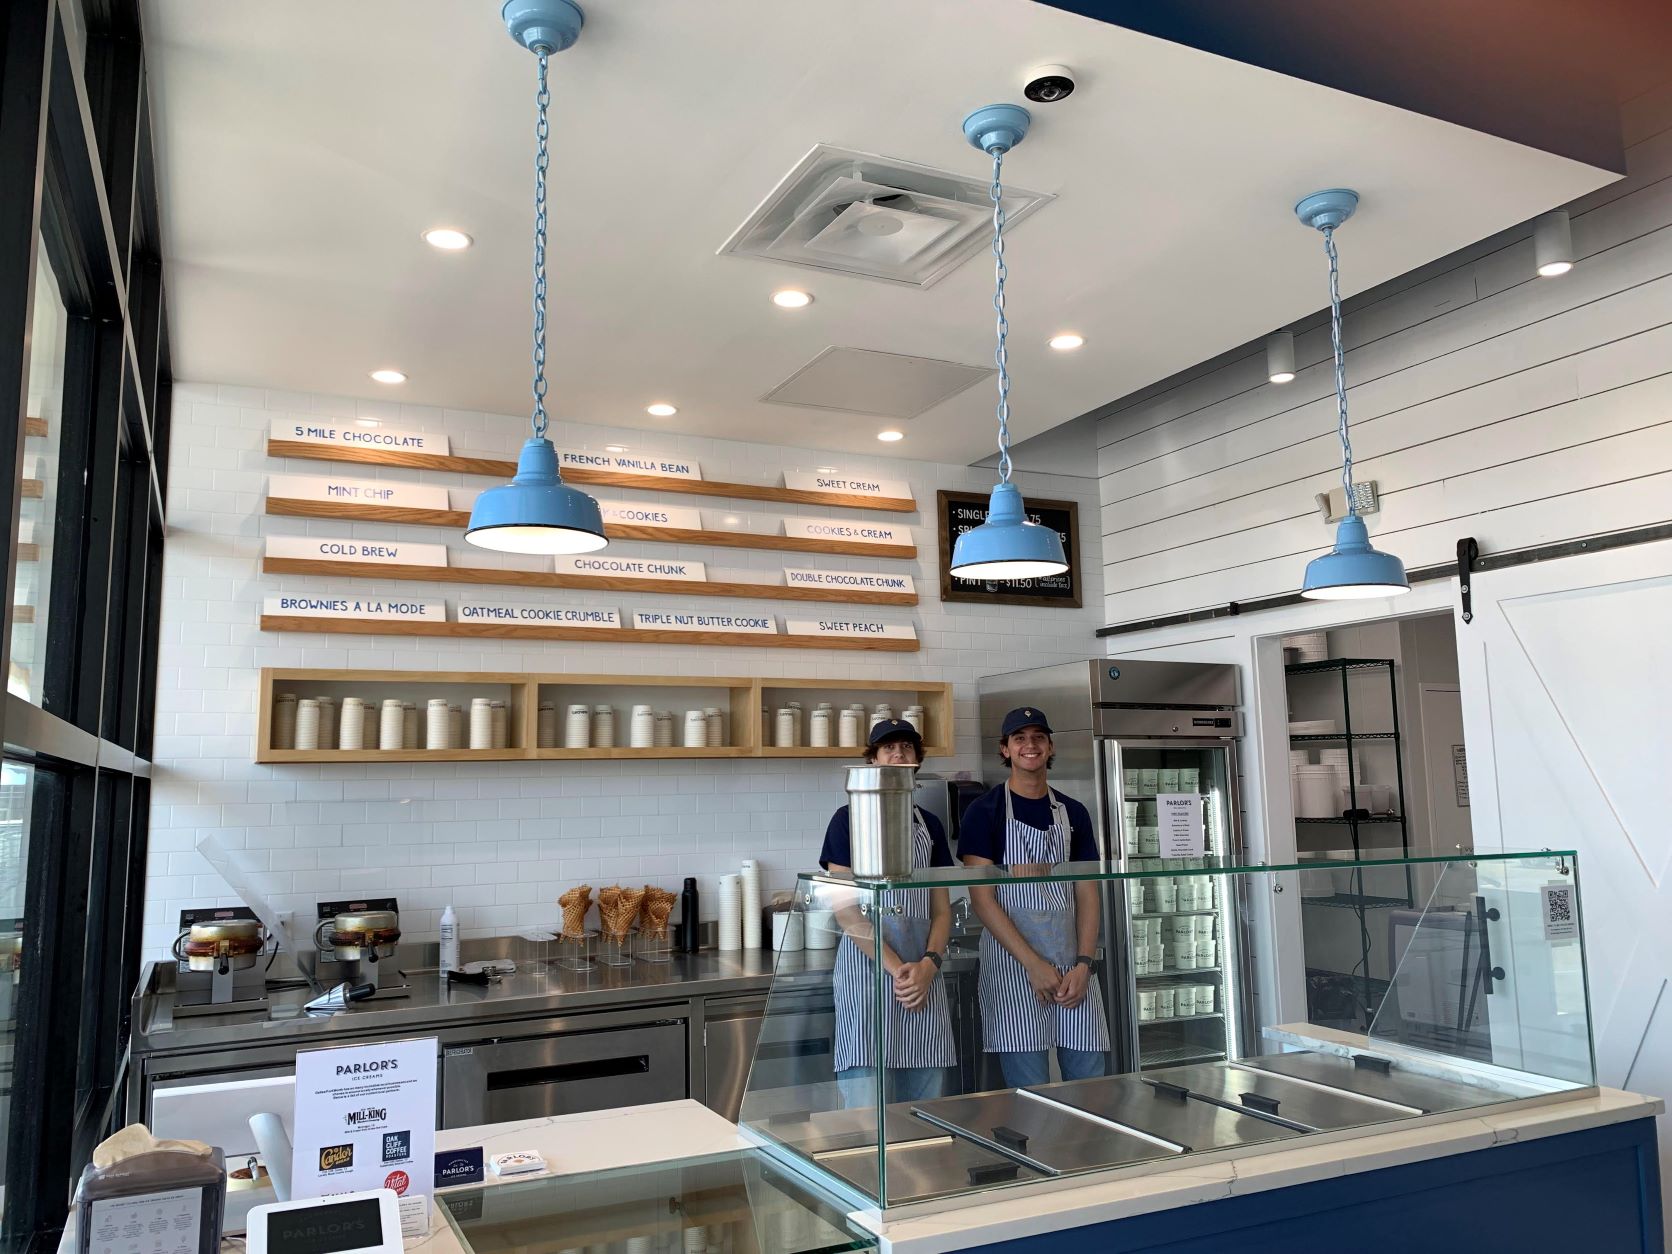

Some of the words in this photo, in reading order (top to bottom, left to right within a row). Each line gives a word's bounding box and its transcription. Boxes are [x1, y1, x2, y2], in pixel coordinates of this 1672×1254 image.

[295, 426, 304, 437] 5
[307, 428, 336, 440] MILE
[343, 431, 424, 448] CHOCOLATE
[564, 453, 610, 467] FRENCH
[615, 457, 657, 472] VANILLA
[661, 462, 690, 474] BEAN
[328, 485, 359, 499] MINT
[364, 487, 394, 501] CHIP
[816, 478, 848, 490] SWEET
[849, 481, 880, 493] CREAM
[619, 510, 668, 523] COOKIES
[806, 524, 853, 537] COOKIES
[860, 528, 893, 540] CREAM
[319, 543, 357, 556] COLD
[361, 546, 398, 558] BREW
[574, 559, 643, 574] CHOCOLATE
[647, 563, 687, 576] CHUNK
[790, 572, 823, 584] DOUBLE
[825, 575, 875, 588] CHOCOLATE
[876, 577, 905, 588] CHUNK
[280, 598, 348, 612] BROWNIES
[353, 601, 362, 612] A
[367, 602, 383, 613] LA
[388, 603, 426, 615] MODE
[462, 606, 518, 619] OATMEAL
[520, 608, 563, 621] COOKIE
[565, 610, 615, 623] CRUMBLE
[638, 613, 672, 626] TRIPLE
[674, 615, 695, 626] NUT
[697, 616, 733, 628] BUTTER
[734, 617, 769, 629] COOKIE
[819, 621, 850, 632] SWEET
[853, 622, 885, 634] PEACH
[336, 1059, 398, 1076] PARLOR'S
[347, 1108, 387, 1125] MILL-KING
[385, 1140, 402, 1149] CLIFF
[386, 1135, 399, 1143] OAK
[385, 1146, 407, 1155] COFFEE
[442, 1165, 474, 1176] PARLOR'S
